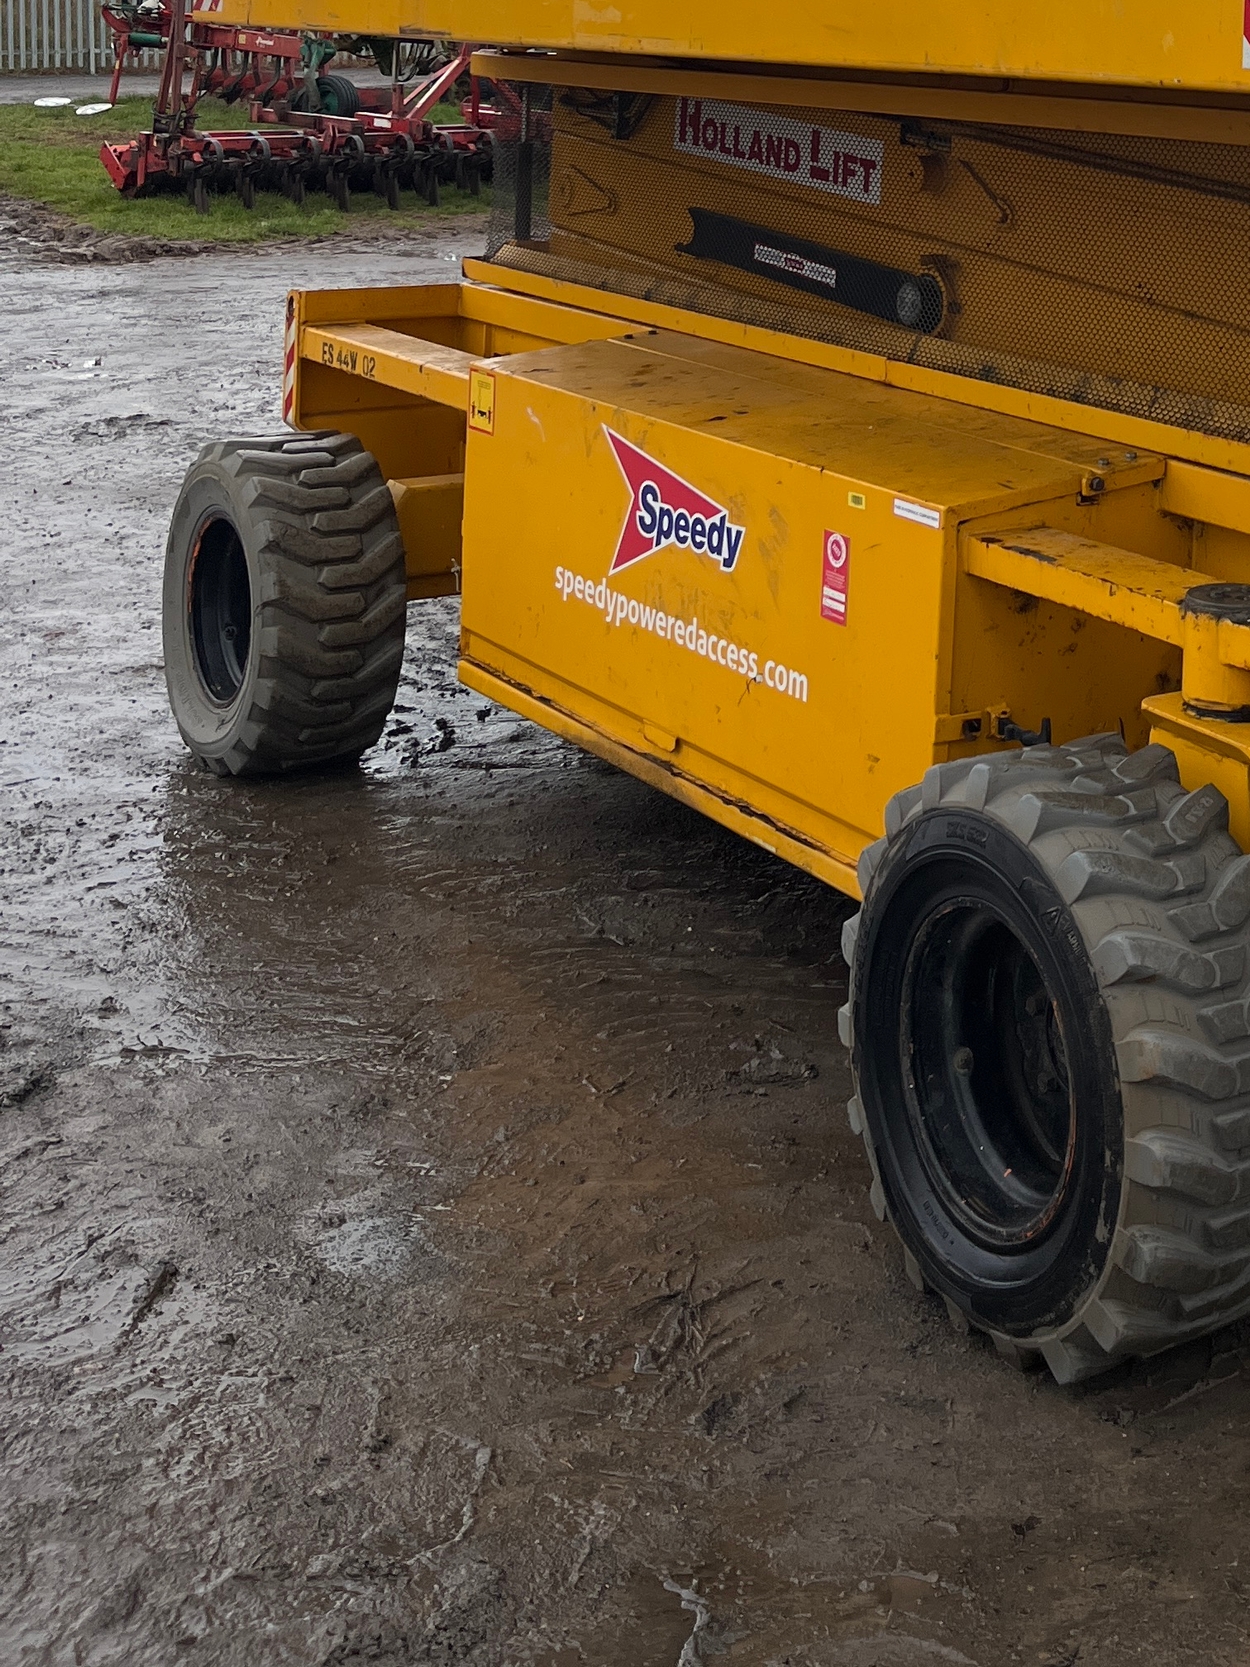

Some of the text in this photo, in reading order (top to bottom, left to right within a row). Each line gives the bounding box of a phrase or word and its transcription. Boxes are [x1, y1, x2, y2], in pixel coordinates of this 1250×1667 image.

[679, 96, 877, 194] HOLLAND LIFT
[322, 342, 334, 365] ES
[363, 355, 376, 378] 02
[637, 482, 745, 571] Speedy
[555, 566, 809, 703] speedypoweredaccess.com
